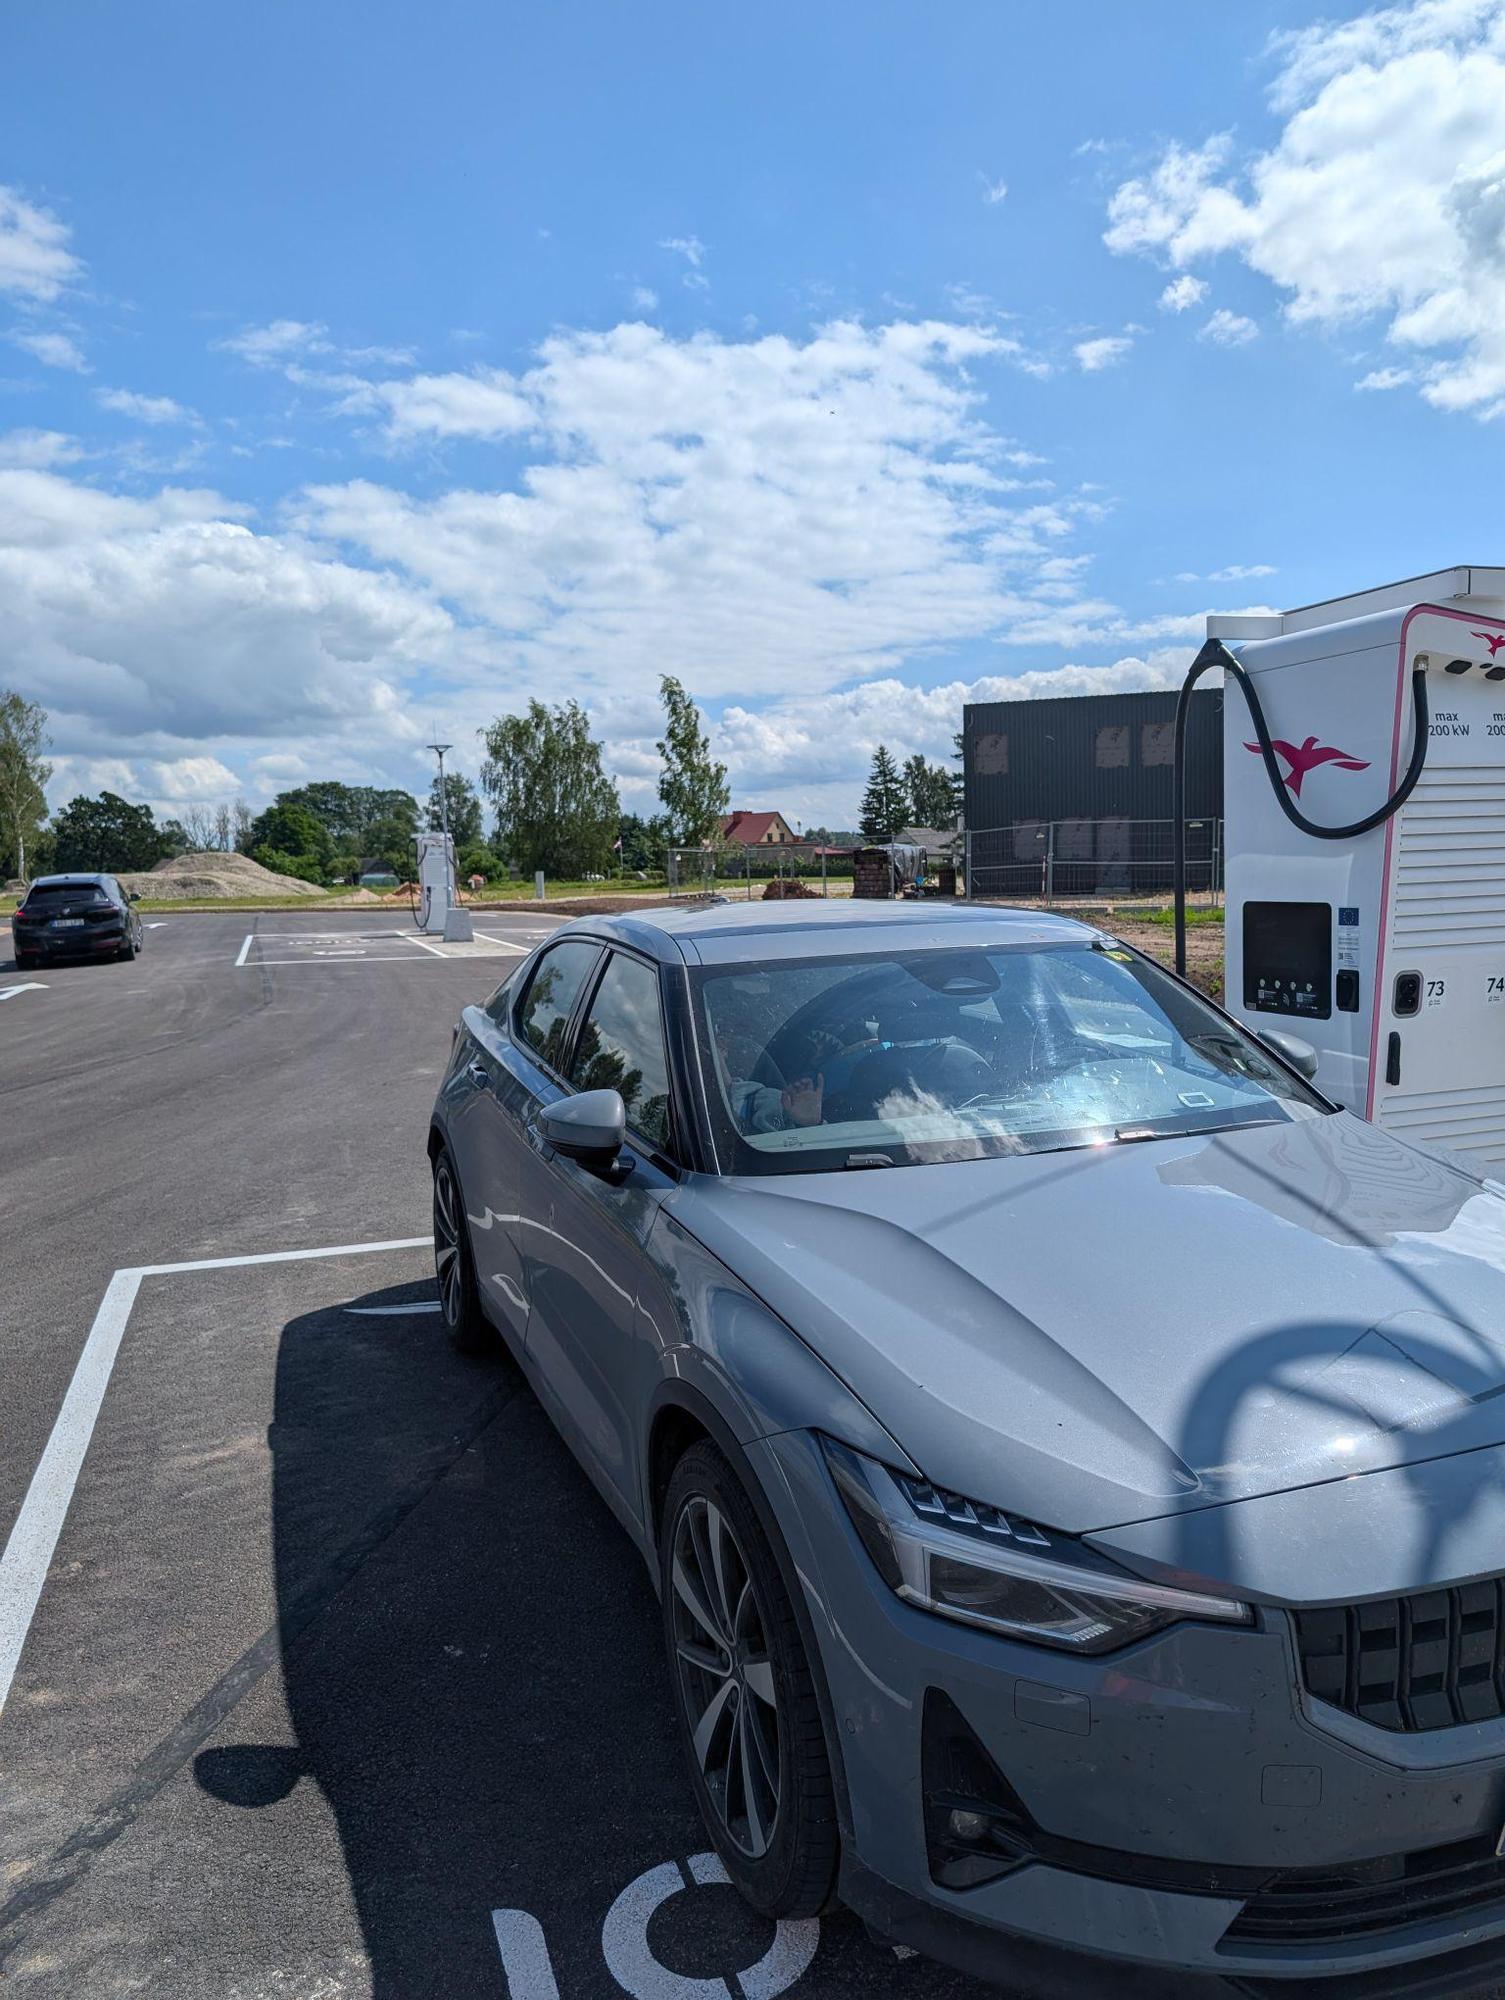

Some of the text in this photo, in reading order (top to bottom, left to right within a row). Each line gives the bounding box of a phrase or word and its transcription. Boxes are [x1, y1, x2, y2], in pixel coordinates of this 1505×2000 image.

[1435, 712, 1459, 721] max
[1428, 724, 1470, 736] 200 kW
[1427, 980, 1445, 997] 73
[1487, 977, 1505, 993] 74
